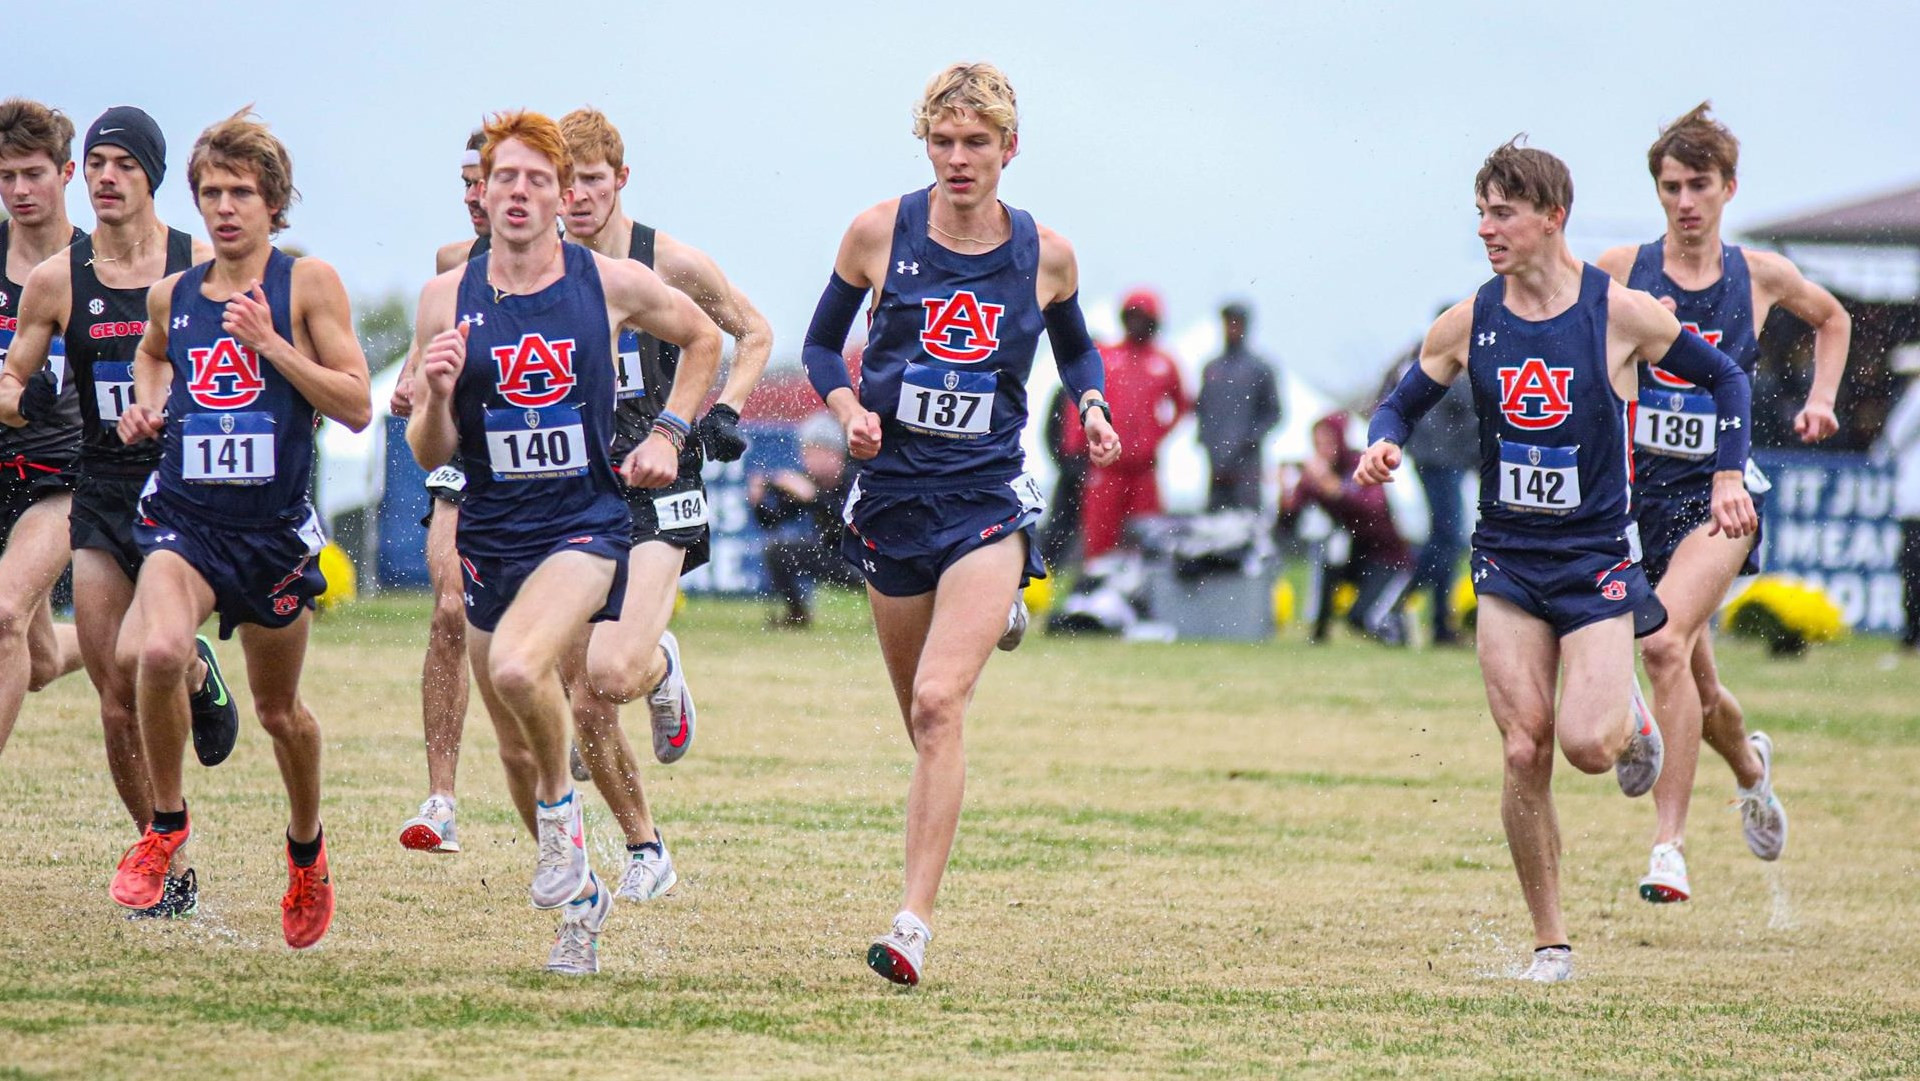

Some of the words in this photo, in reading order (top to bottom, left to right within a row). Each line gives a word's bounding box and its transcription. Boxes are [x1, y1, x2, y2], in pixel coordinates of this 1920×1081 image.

[916, 391, 981, 429] 137
[503, 430, 571, 469] 140
[1648, 413, 1704, 449] 139
[197, 437, 254, 474] 141
[1509, 467, 1566, 504] 142
[1780, 470, 1823, 516] IT
[1828, 471, 1891, 518] JU
[670, 497, 701, 522] 164
